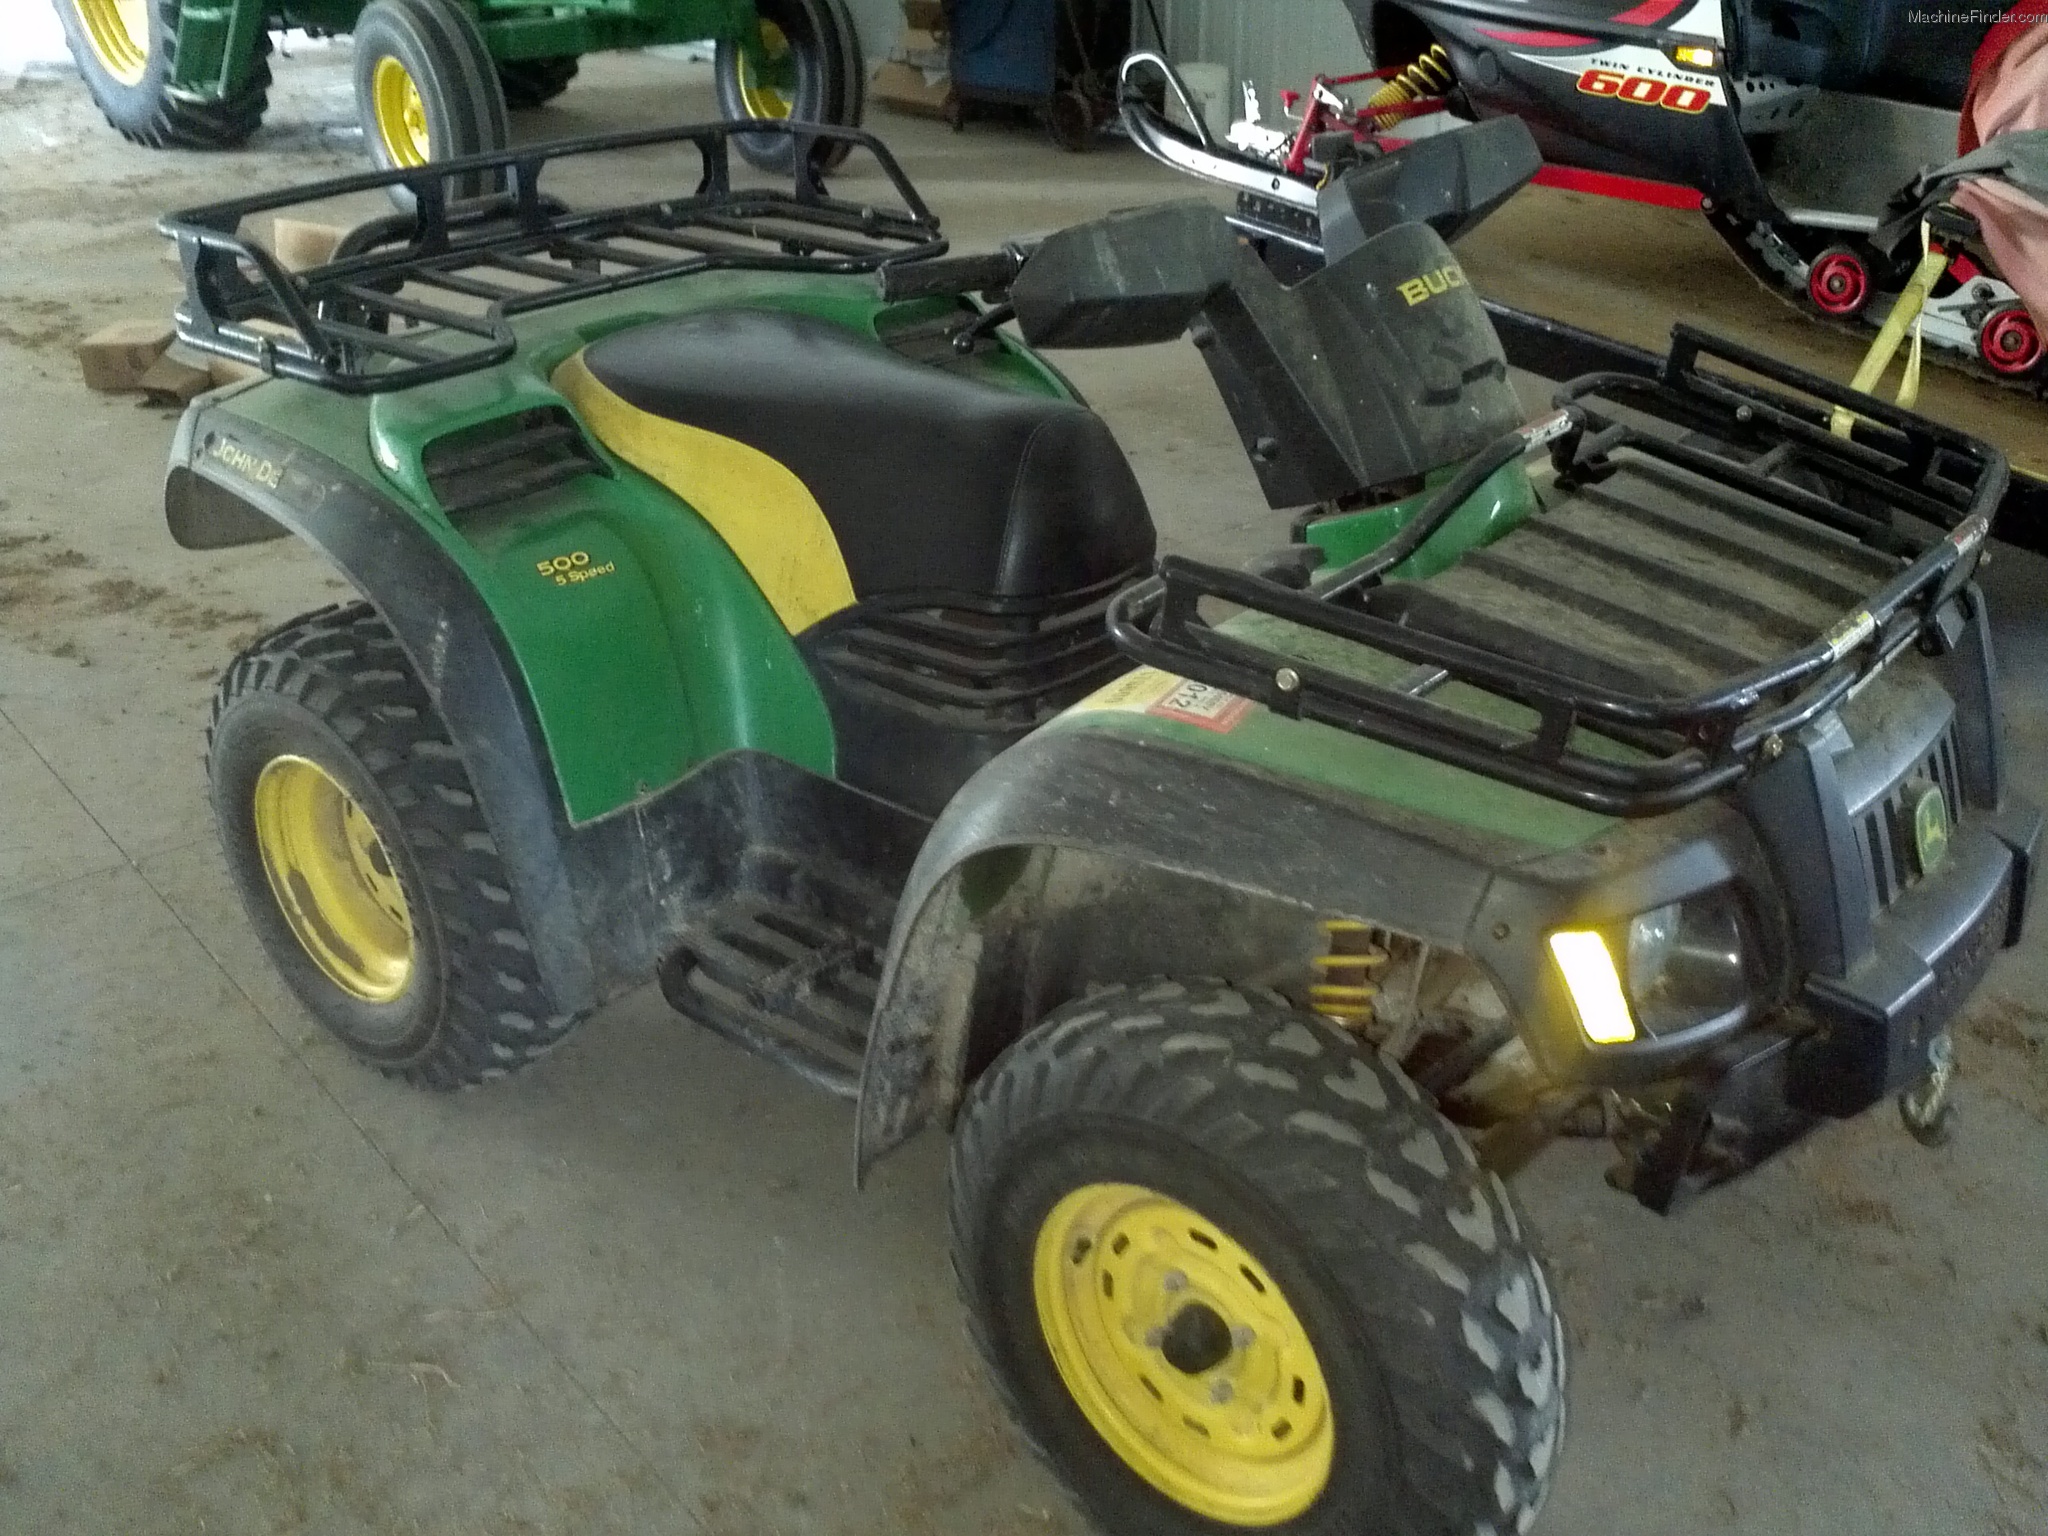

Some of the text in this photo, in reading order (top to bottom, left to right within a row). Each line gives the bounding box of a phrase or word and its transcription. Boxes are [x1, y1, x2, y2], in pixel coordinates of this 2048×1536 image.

[1591, 57, 1716, 88] TWIN CYLINDER
[1576, 69, 1711, 115] 600
[536, 551, 590, 577] 500
[555, 560, 616, 586] 5 Speed
